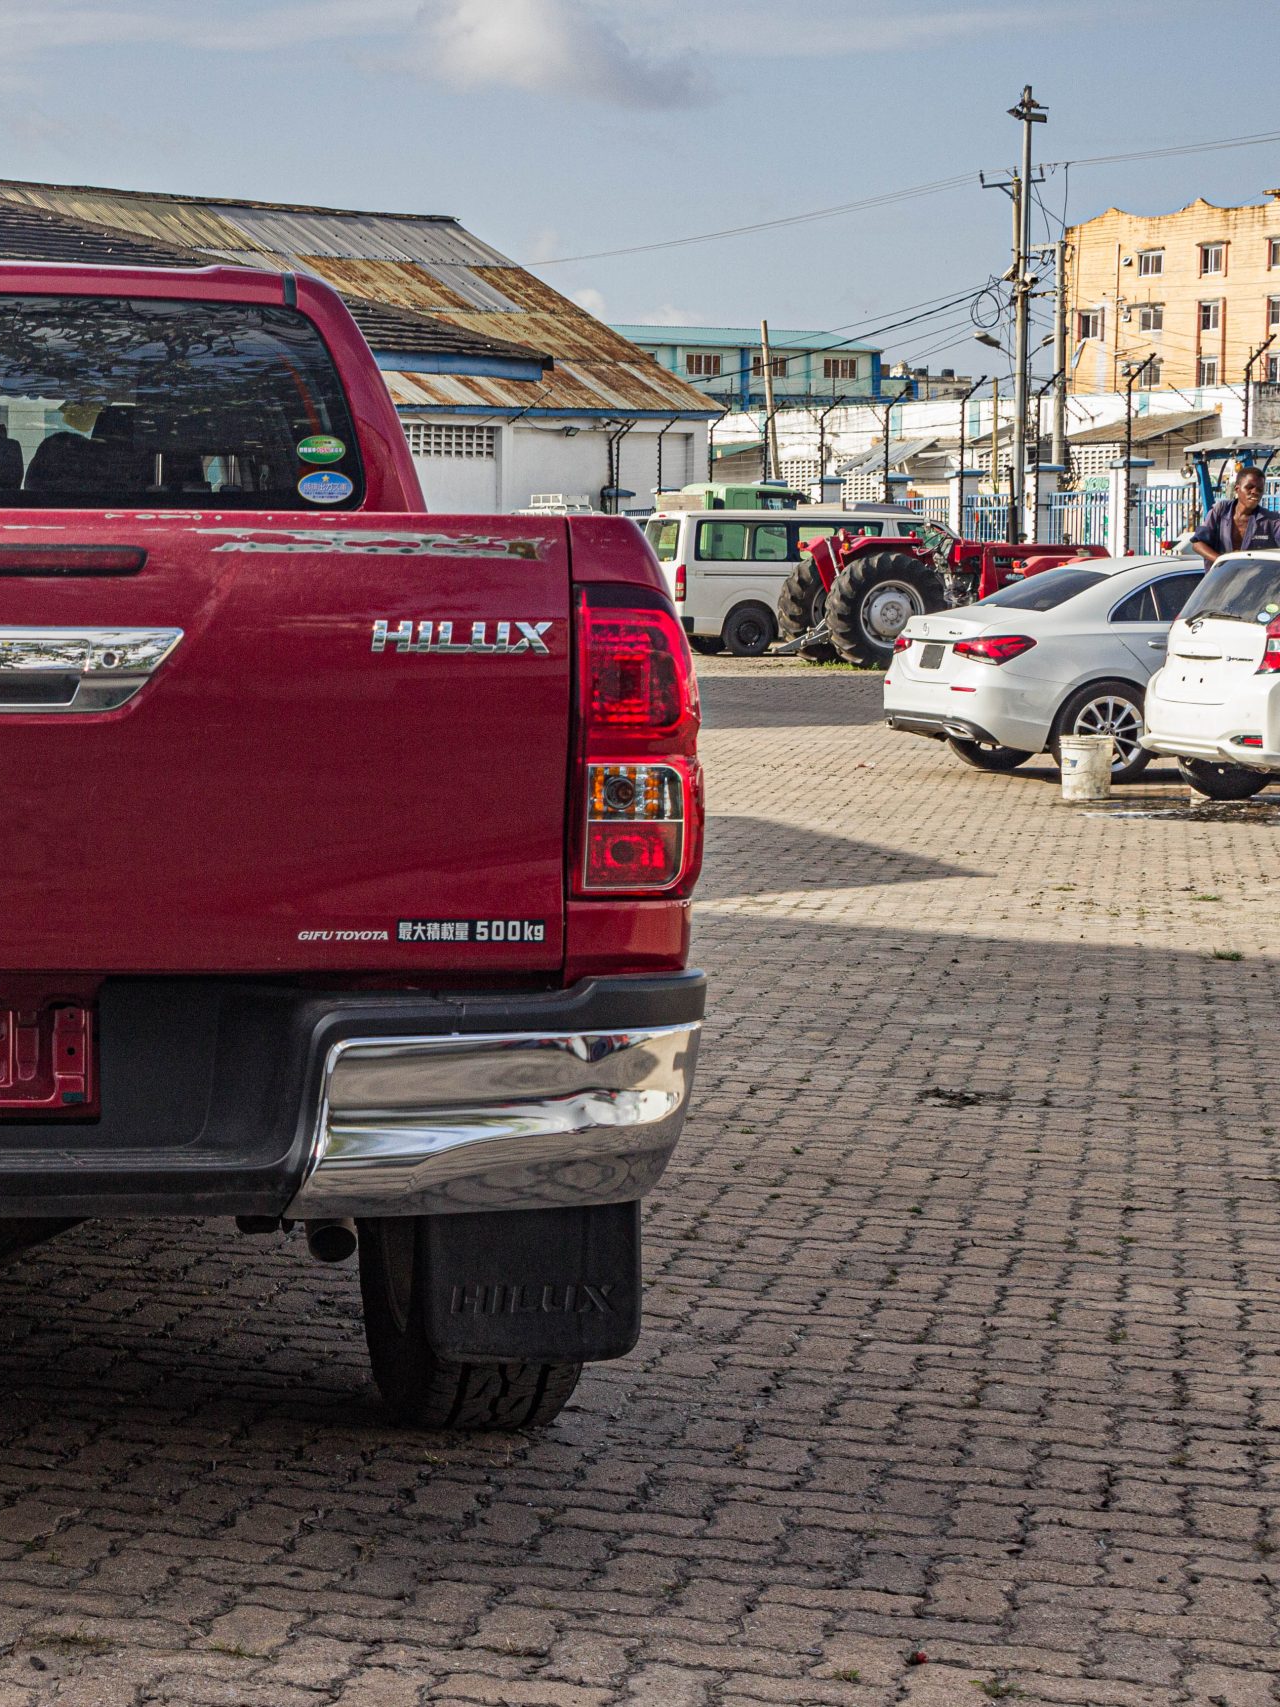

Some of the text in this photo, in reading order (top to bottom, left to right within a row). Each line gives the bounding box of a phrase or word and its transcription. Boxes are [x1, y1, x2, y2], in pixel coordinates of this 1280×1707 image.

[371, 619, 553, 654] HILUX
[297, 930, 389, 941] GIFU TOYOTA
[398, 920, 544, 941] 最大積載量 500kg
[450, 1285, 616, 1314] HILUX
